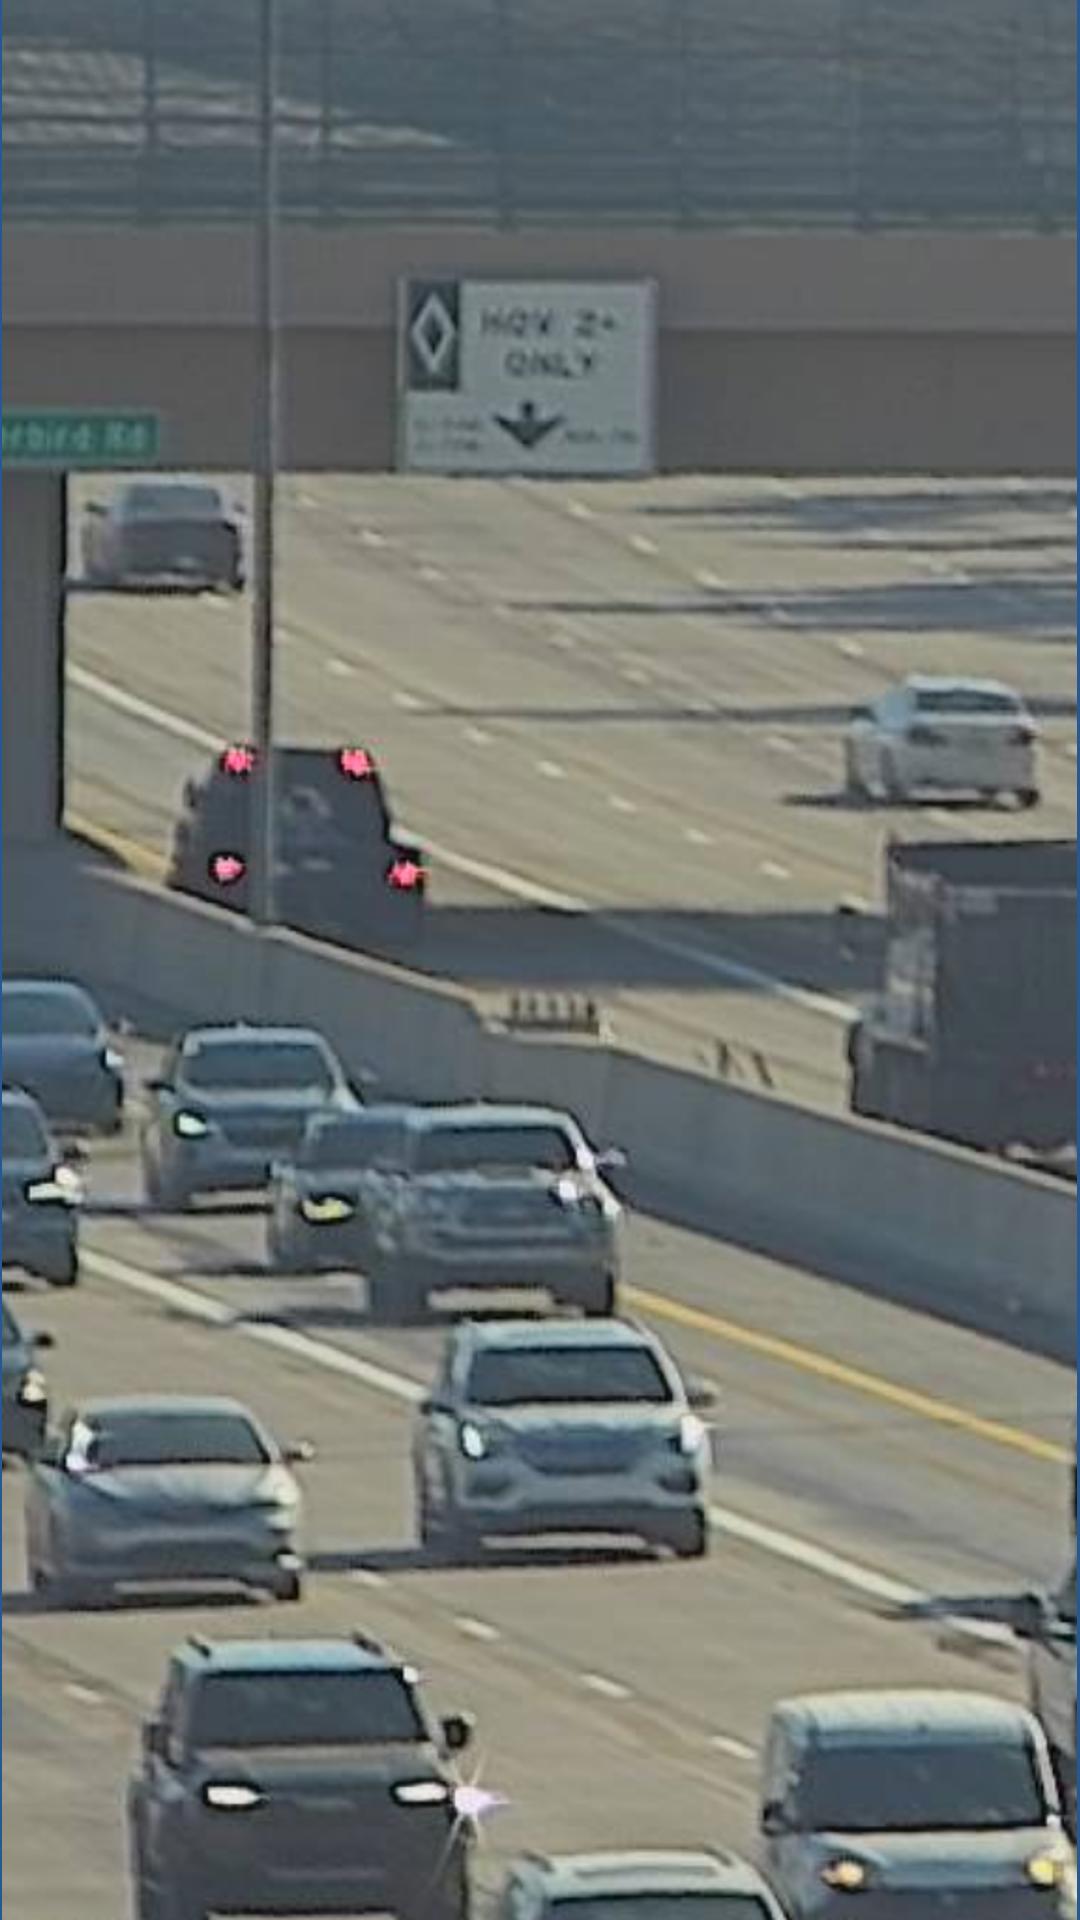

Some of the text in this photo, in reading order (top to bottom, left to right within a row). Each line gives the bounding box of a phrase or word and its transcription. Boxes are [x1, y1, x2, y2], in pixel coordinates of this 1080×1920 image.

[481, 307, 555, 336] HOV
[504, 348, 599, 377] ONLY
[105, 421, 145, 449] Rd
